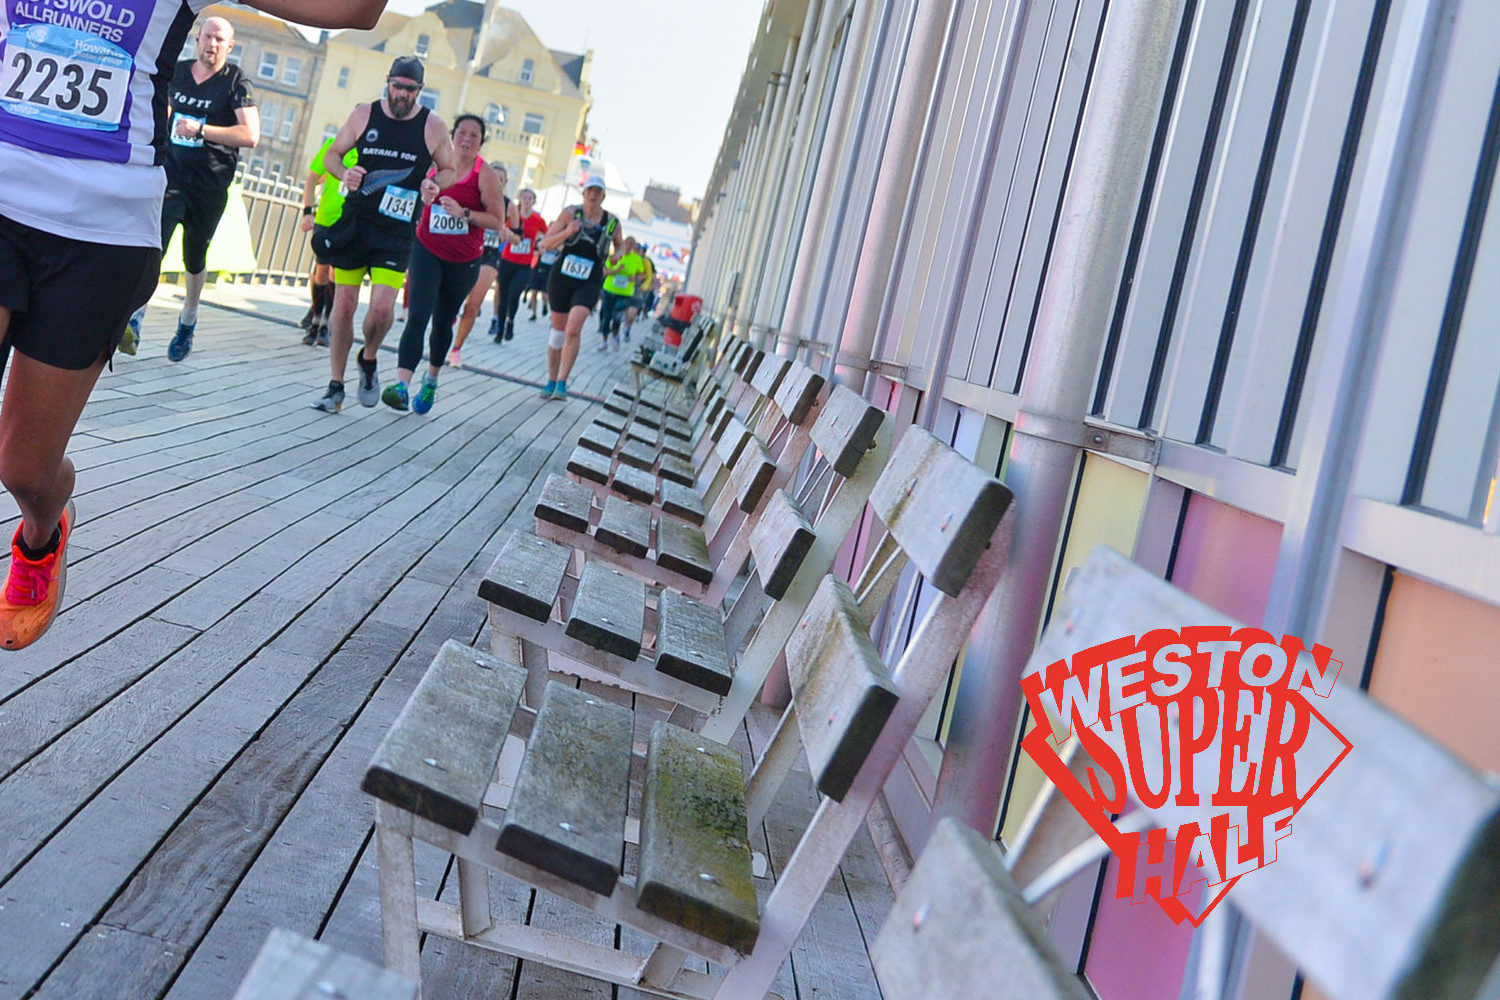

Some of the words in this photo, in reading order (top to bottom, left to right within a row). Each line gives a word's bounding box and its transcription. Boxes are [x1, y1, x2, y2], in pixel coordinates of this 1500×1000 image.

[15, 1, 124, 43] ALLRUNNERS
[4, 52, 113, 116] 2235
[433, 215, 464, 230] 2006
[565, 261, 589, 276] 1637
